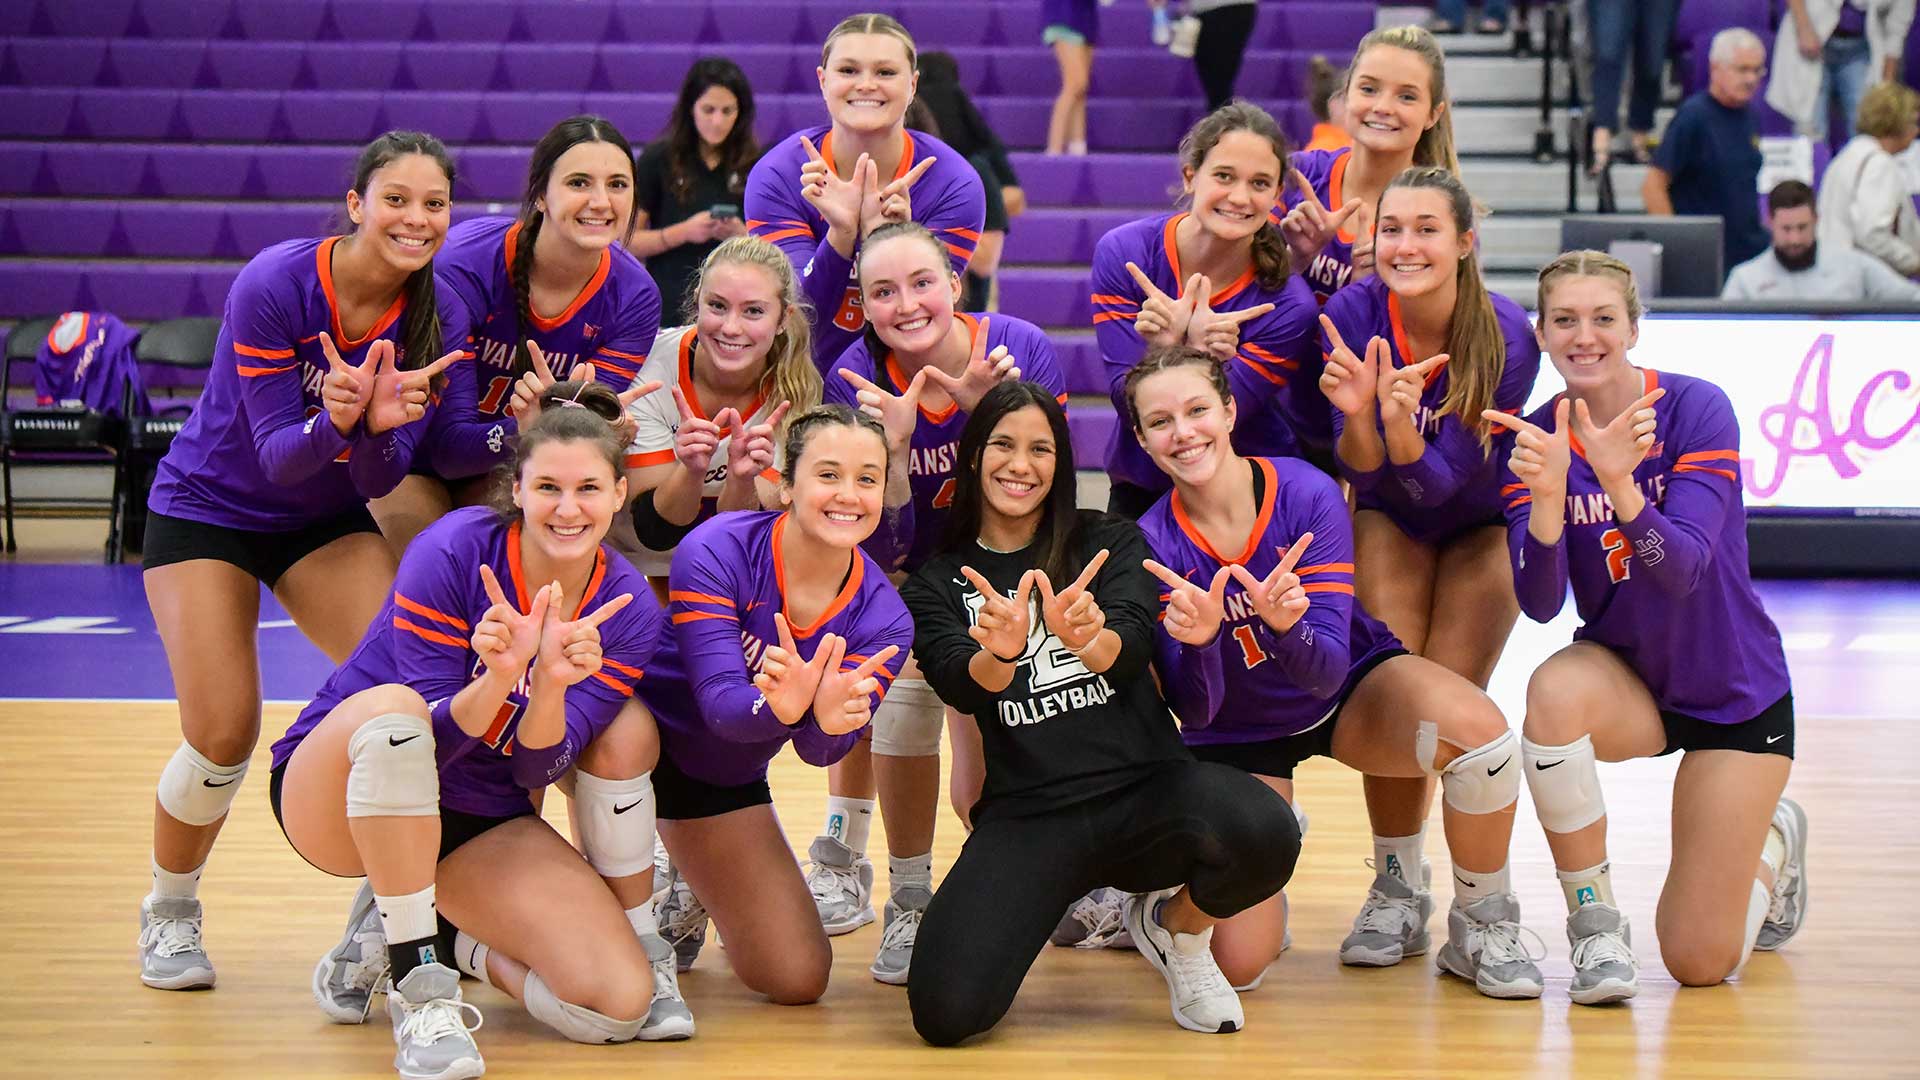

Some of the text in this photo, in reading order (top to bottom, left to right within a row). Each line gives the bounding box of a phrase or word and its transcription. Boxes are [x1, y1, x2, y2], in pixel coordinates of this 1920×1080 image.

[478, 375, 515, 417] 1
[1741, 333, 1920, 498] Ac
[1600, 528, 1633, 584] 2
[1232, 624, 1274, 670] 1
[482, 698, 520, 756] 1
